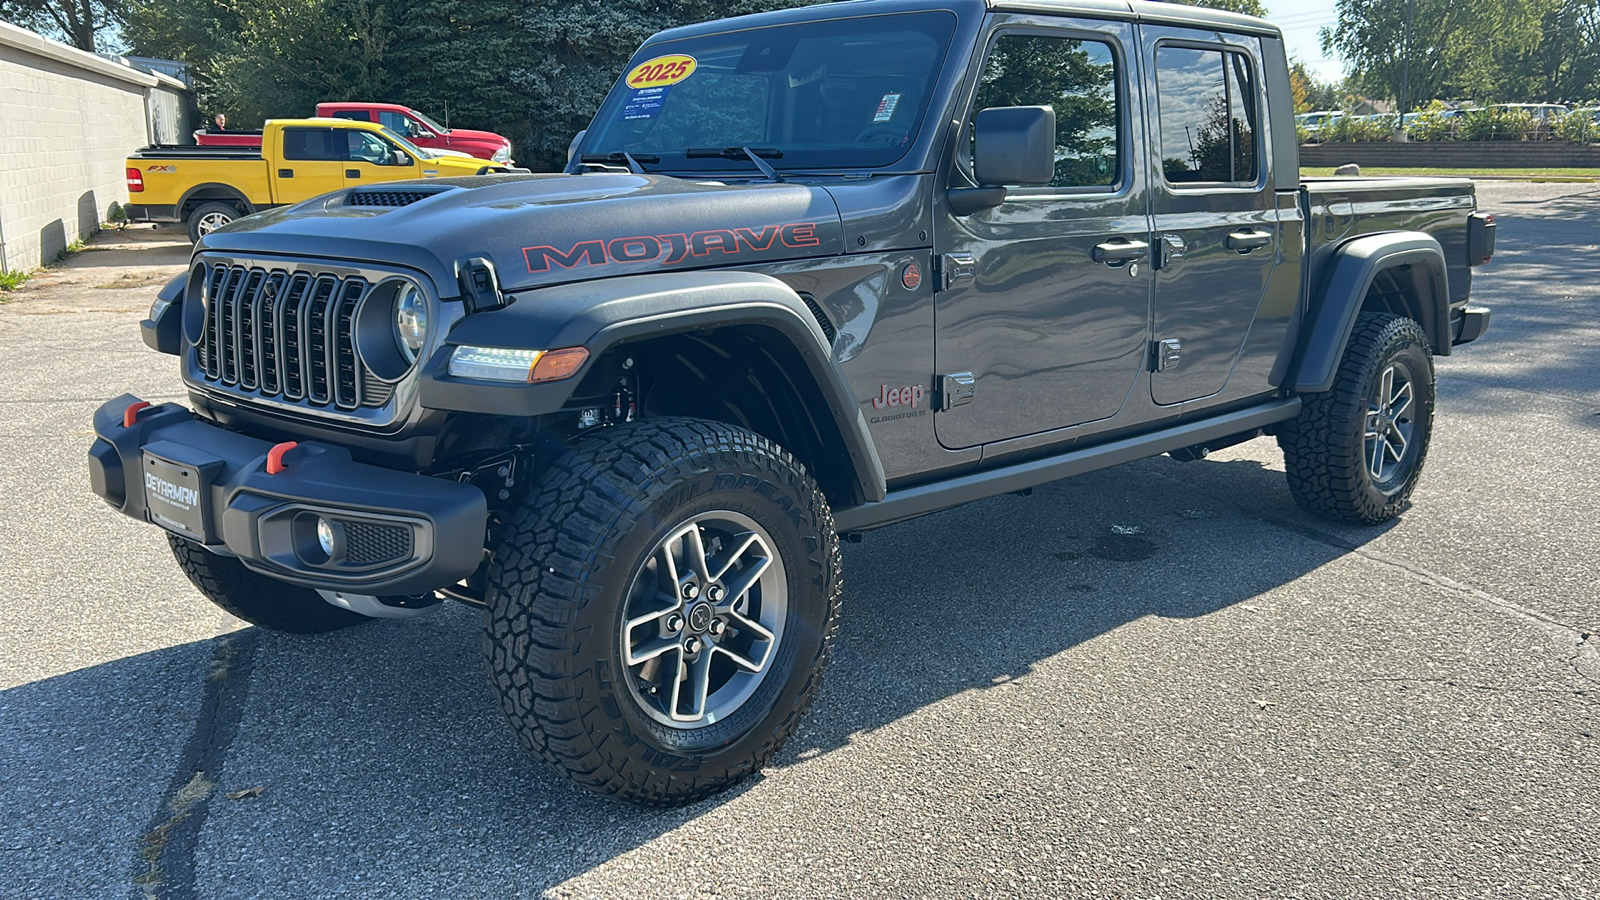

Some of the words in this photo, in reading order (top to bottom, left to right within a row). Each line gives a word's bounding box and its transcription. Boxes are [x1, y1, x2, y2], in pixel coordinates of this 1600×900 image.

[631, 60, 692, 84] 2025
[522, 222, 820, 273] MOJAVE
[872, 384, 924, 410] Jeep
[870, 411, 918, 424] GLADIATOR
[146, 472, 198, 506] DEYARMAN
